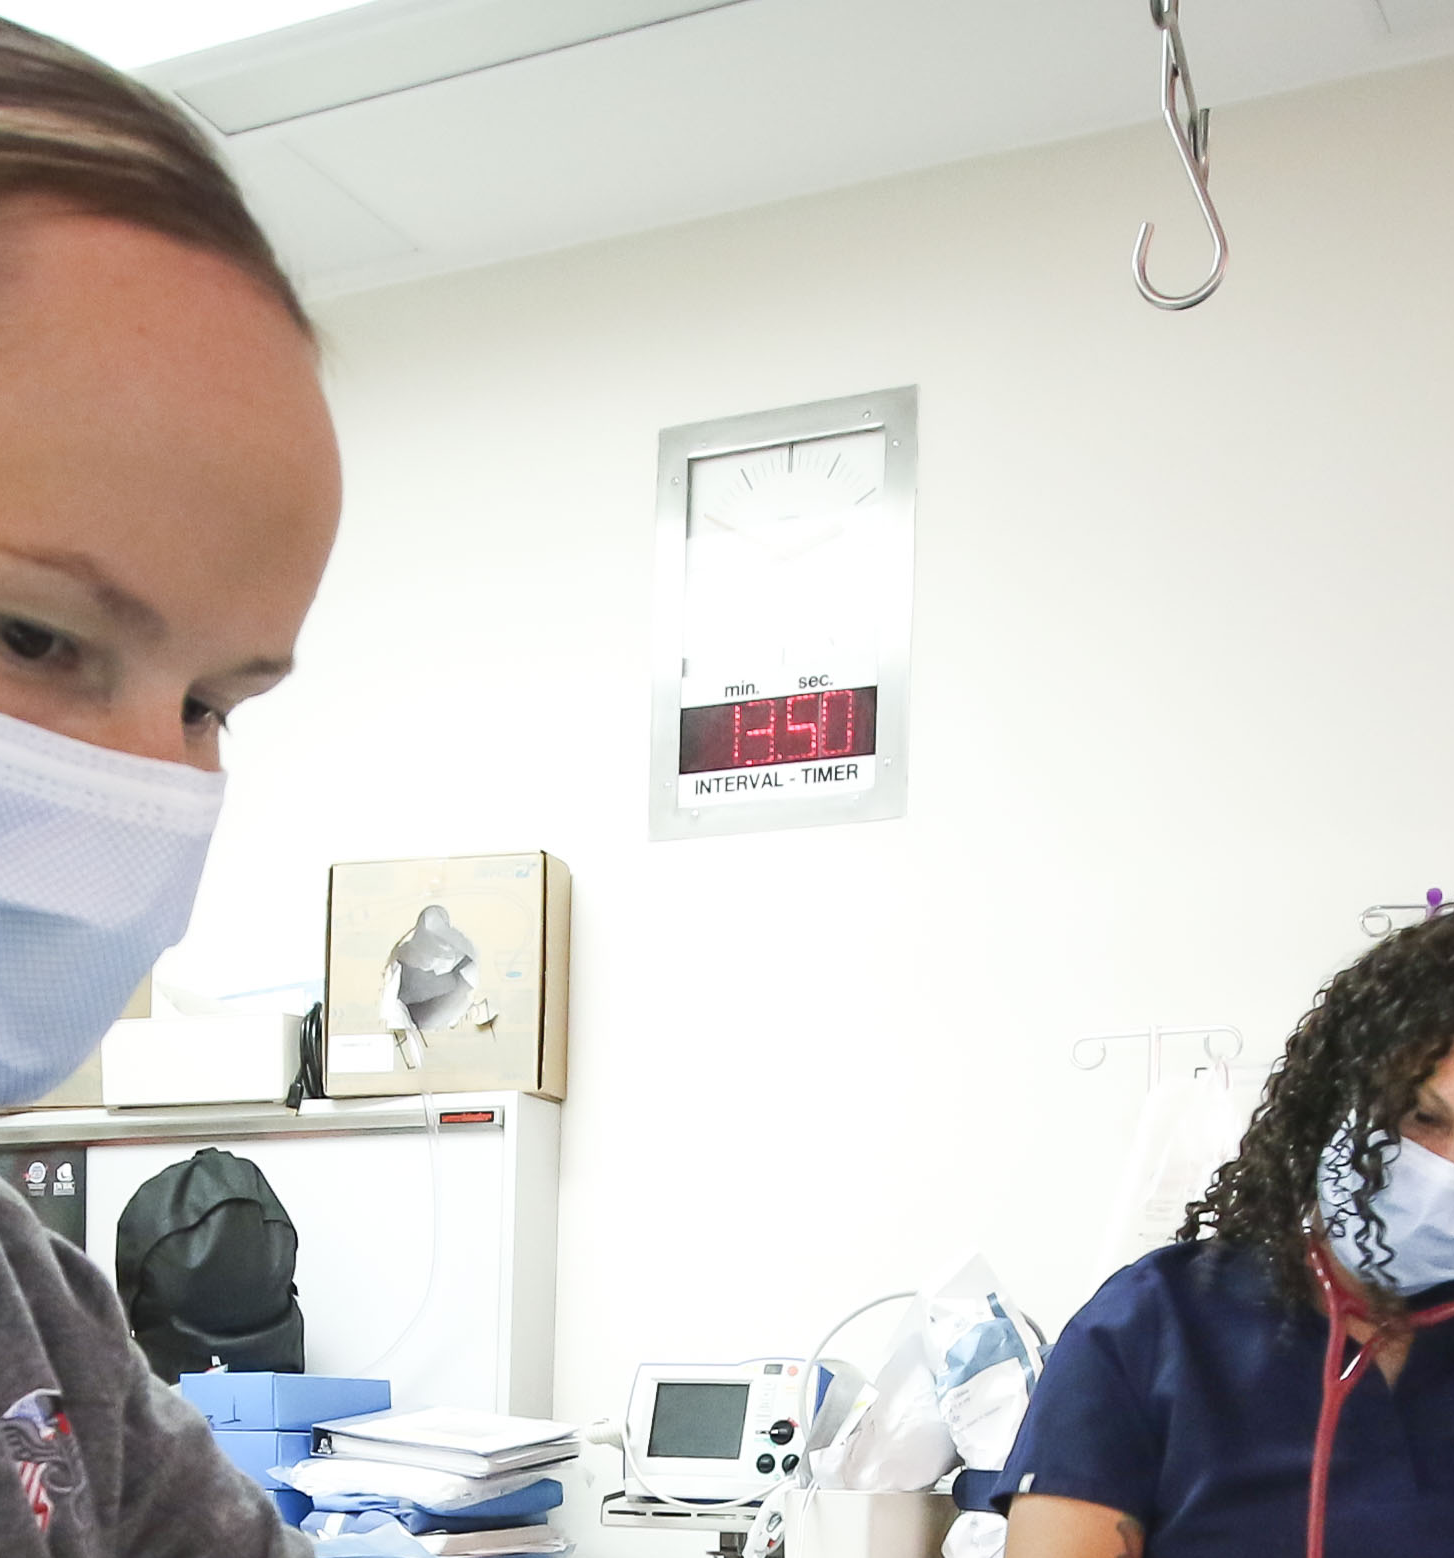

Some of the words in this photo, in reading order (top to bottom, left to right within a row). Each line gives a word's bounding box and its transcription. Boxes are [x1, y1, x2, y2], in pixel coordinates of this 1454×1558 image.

[725, 680, 760, 698] min.
[798, 673, 834, 689] sec.
[695, 771, 784, 796] INTERVAL
[801, 763, 859, 785] TIMER
